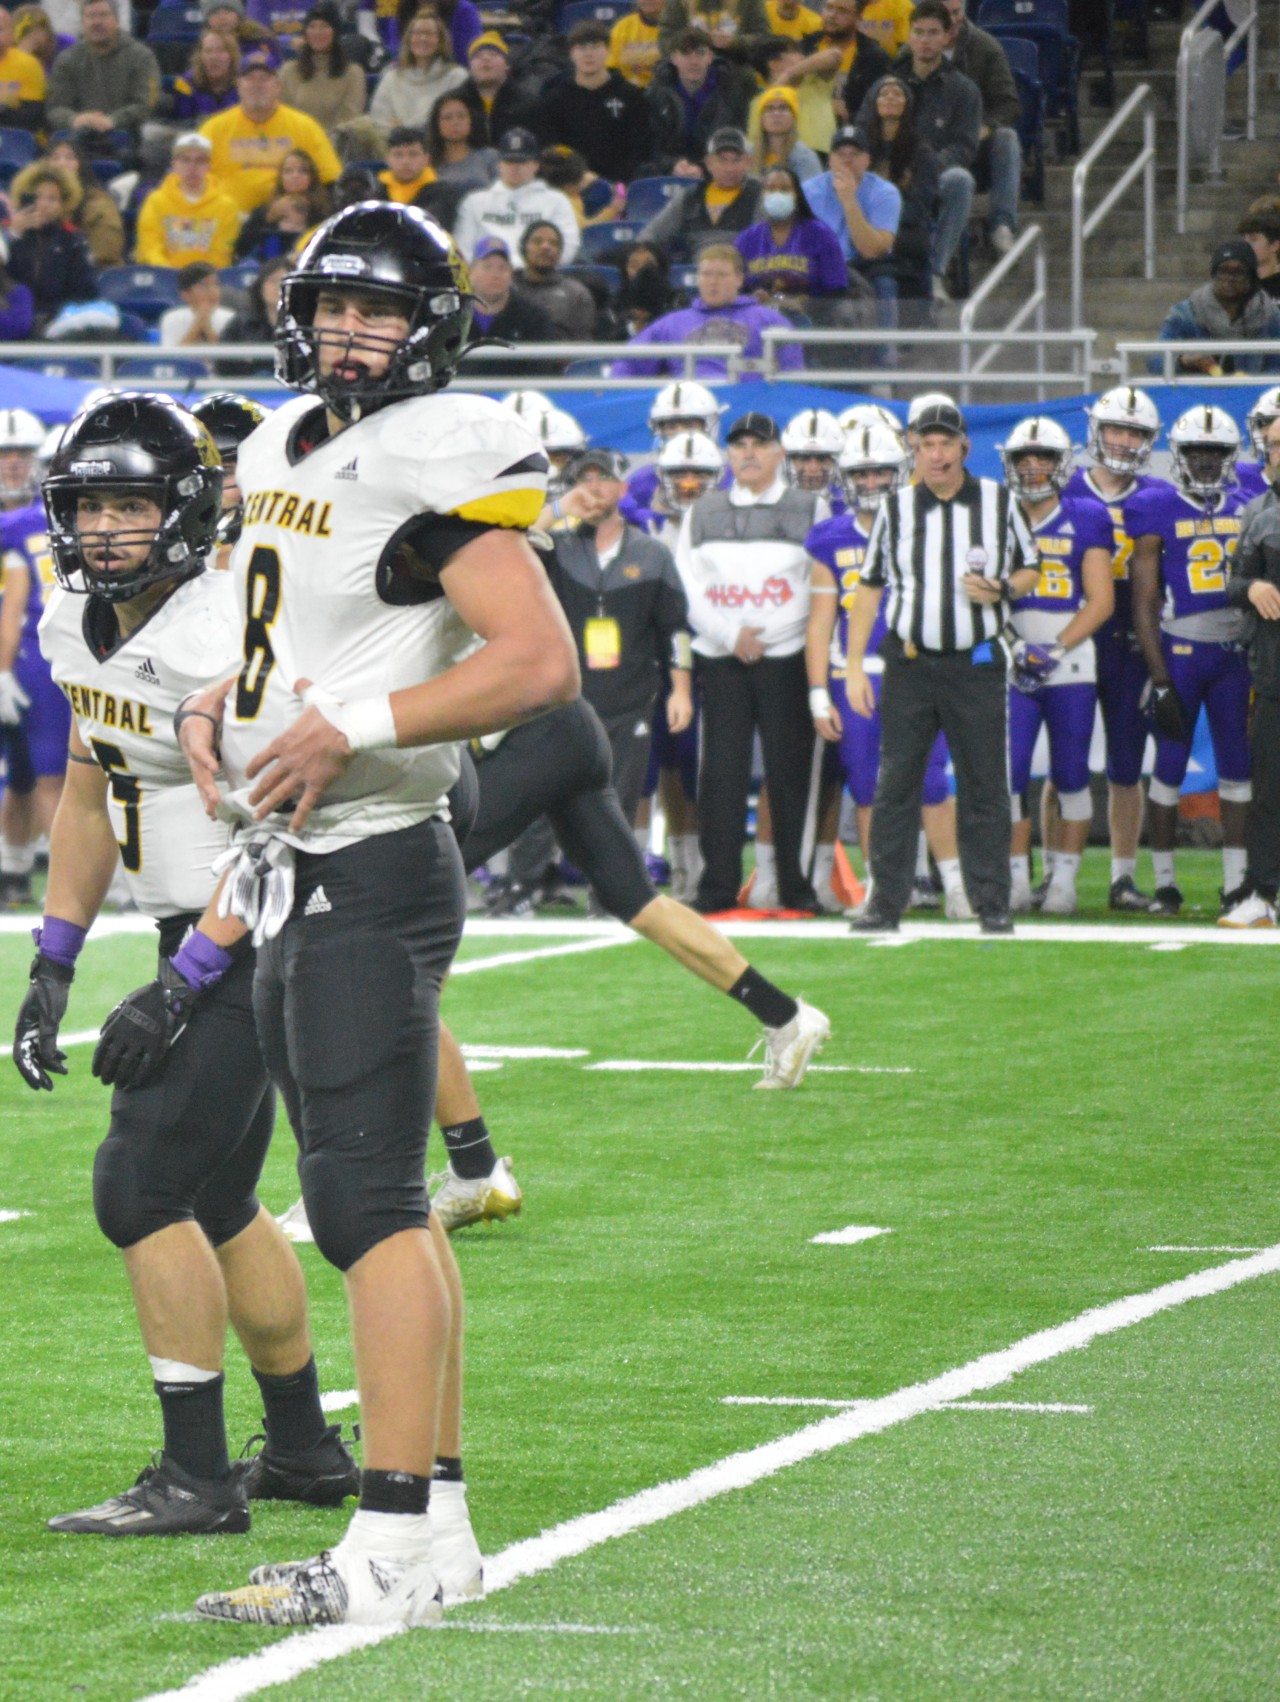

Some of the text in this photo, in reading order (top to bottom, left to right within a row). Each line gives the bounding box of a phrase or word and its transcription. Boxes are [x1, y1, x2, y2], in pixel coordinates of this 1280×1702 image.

[235, 543, 281, 721] 8
[134, 670, 161, 686] adidas
[304, 901, 332, 916] adidas
